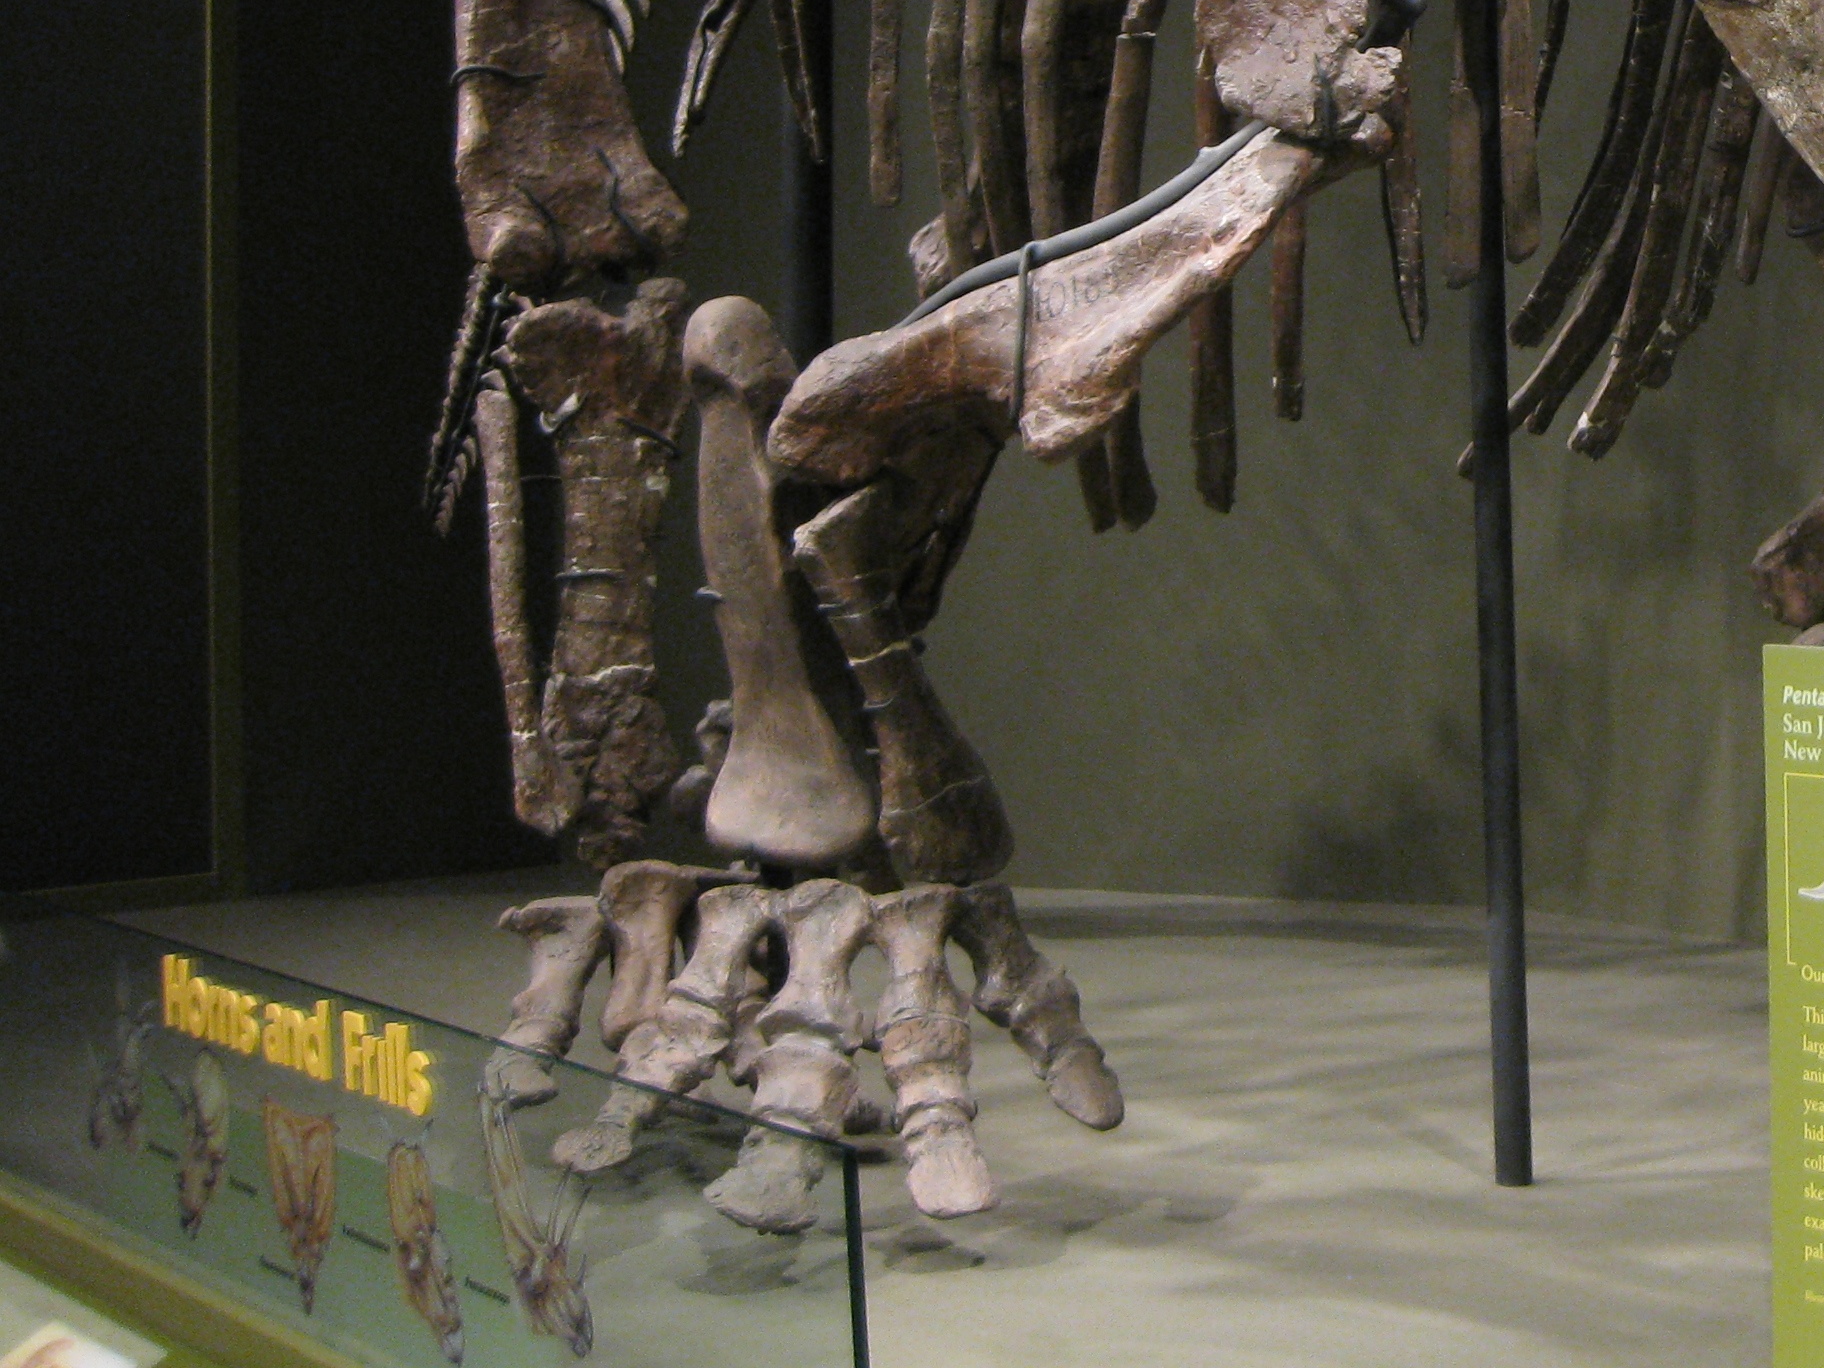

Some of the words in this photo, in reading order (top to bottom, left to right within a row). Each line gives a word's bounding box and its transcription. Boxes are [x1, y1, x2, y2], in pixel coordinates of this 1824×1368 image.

[1783, 713, 1812, 735] San
[1784, 740, 1821, 761] New
[162, 953, 260, 1055] Horns
[262, 999, 333, 1082] and
[342, 1010, 433, 1116] Frills
